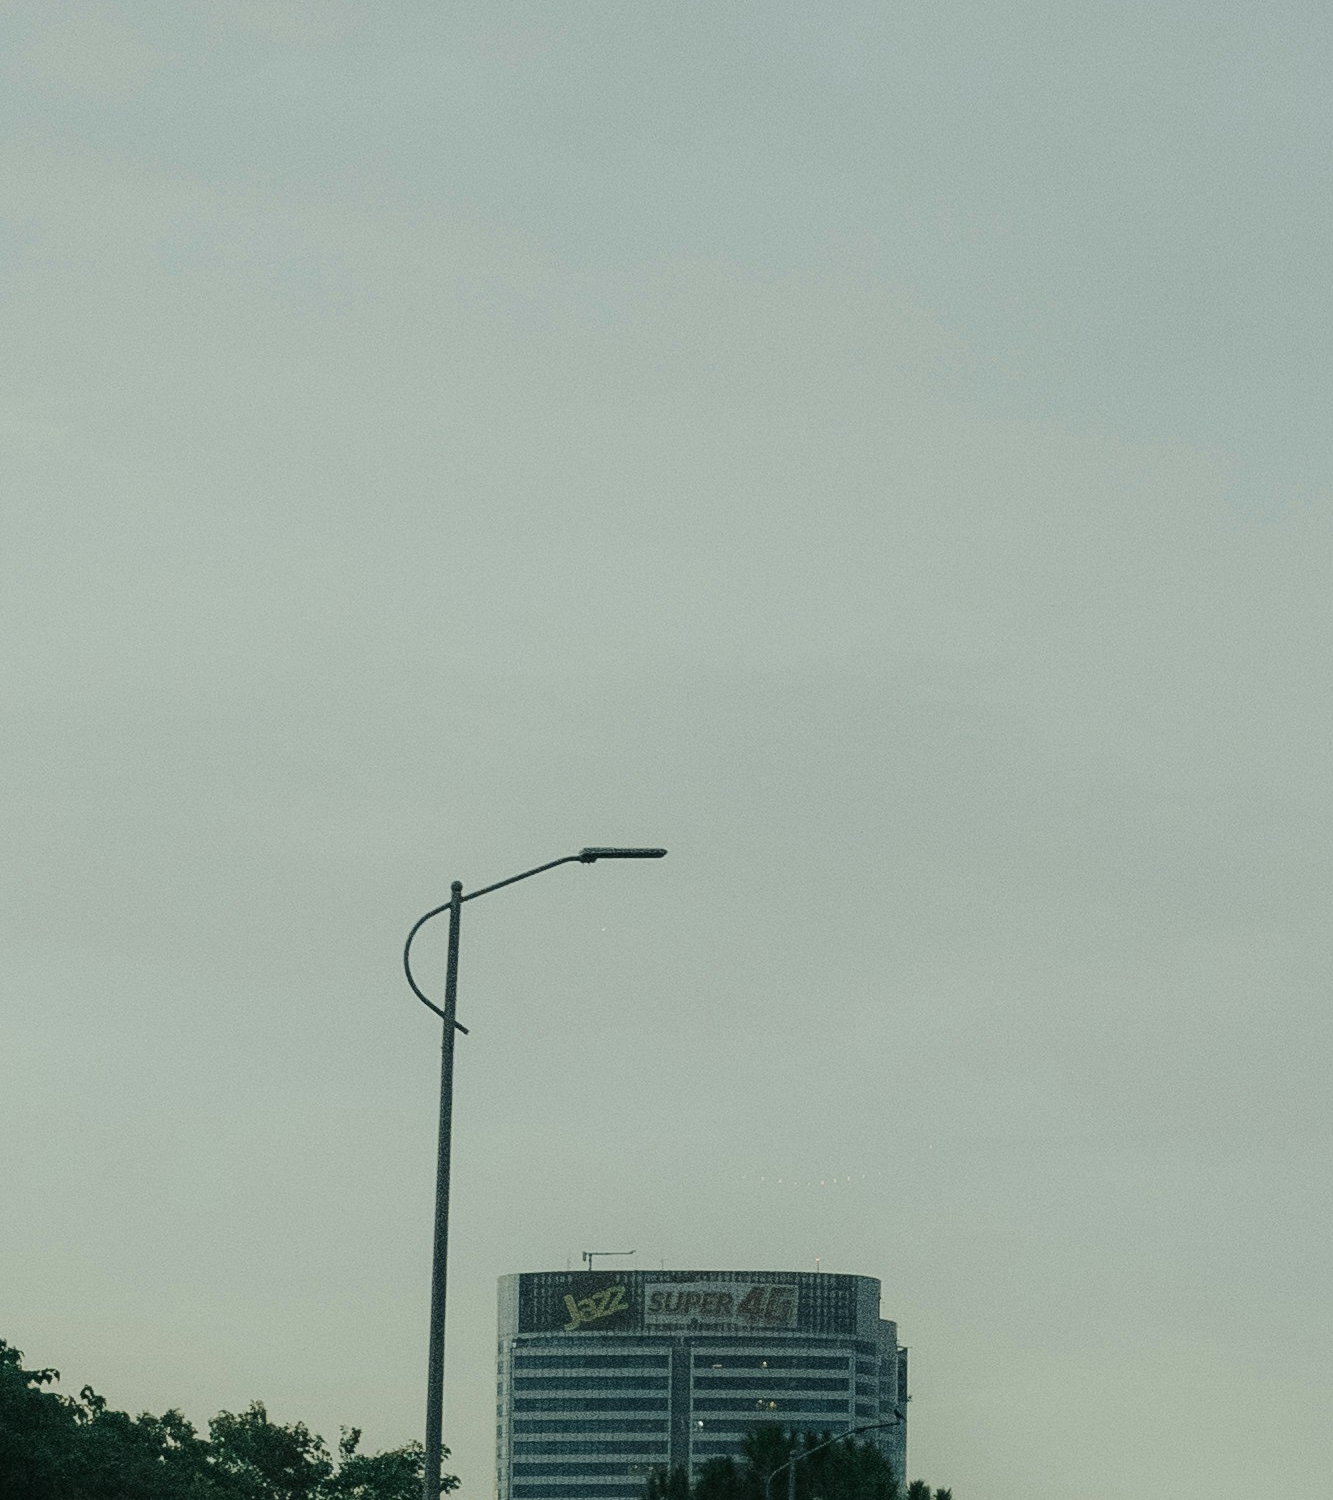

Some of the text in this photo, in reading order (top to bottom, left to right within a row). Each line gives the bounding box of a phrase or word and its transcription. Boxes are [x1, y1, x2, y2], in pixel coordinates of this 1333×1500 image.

[563, 1285, 629, 1331] Jazz
[648, 1286, 793, 1321] SUPER 4G
